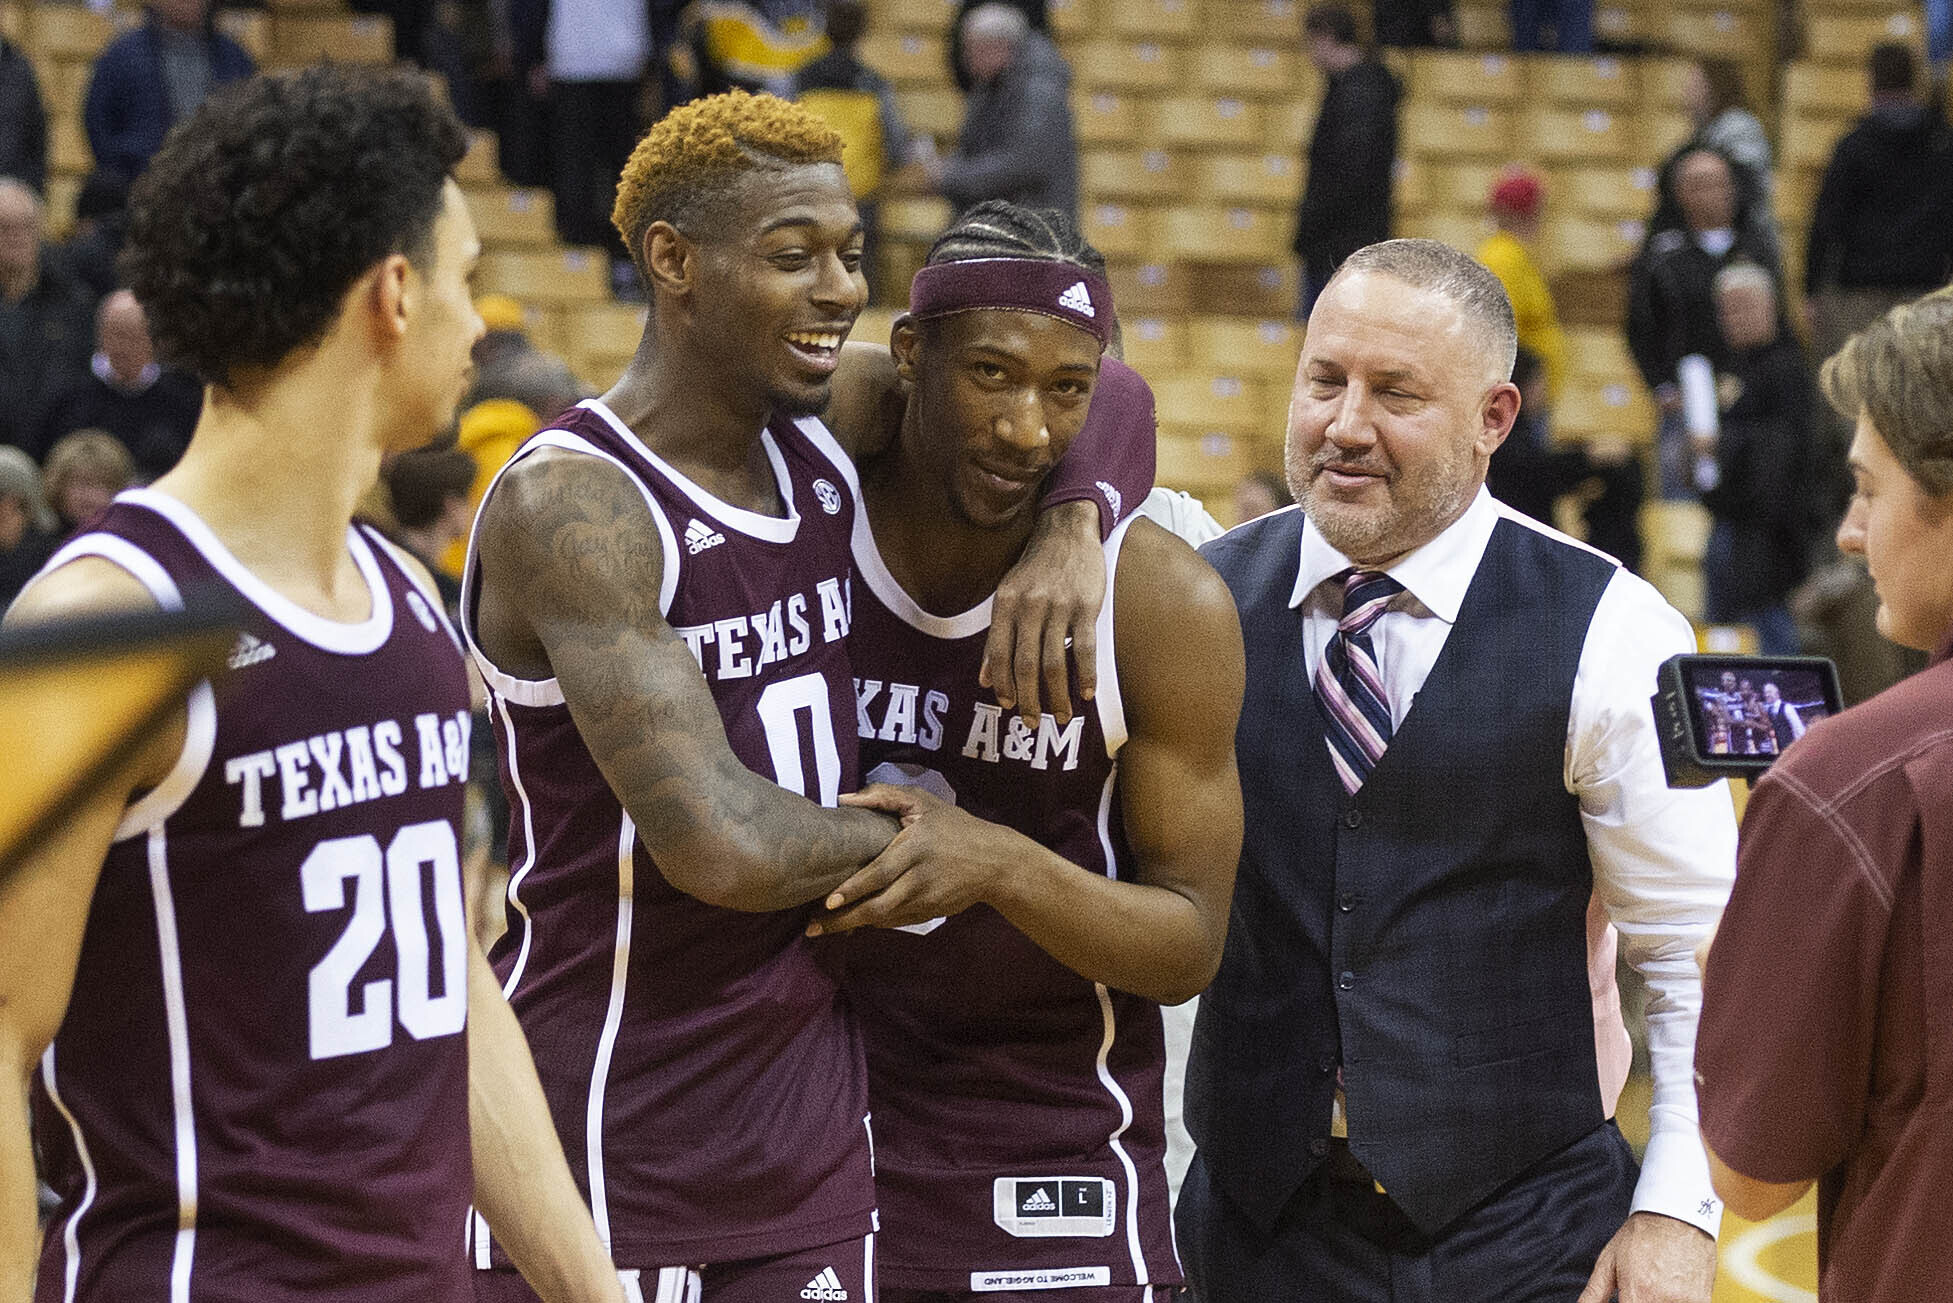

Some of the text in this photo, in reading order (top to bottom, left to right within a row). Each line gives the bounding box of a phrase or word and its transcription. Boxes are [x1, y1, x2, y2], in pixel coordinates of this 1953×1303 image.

[688, 532, 726, 555] adidas
[673, 592, 811, 681] TEXAS
[853, 677, 1085, 772] XAS A&M
[225, 719, 408, 828] TEXAS
[300, 818, 468, 1060] 20
[800, 1287, 848, 1300] adidas
[1050, 1272, 1096, 1283] WELCOME
